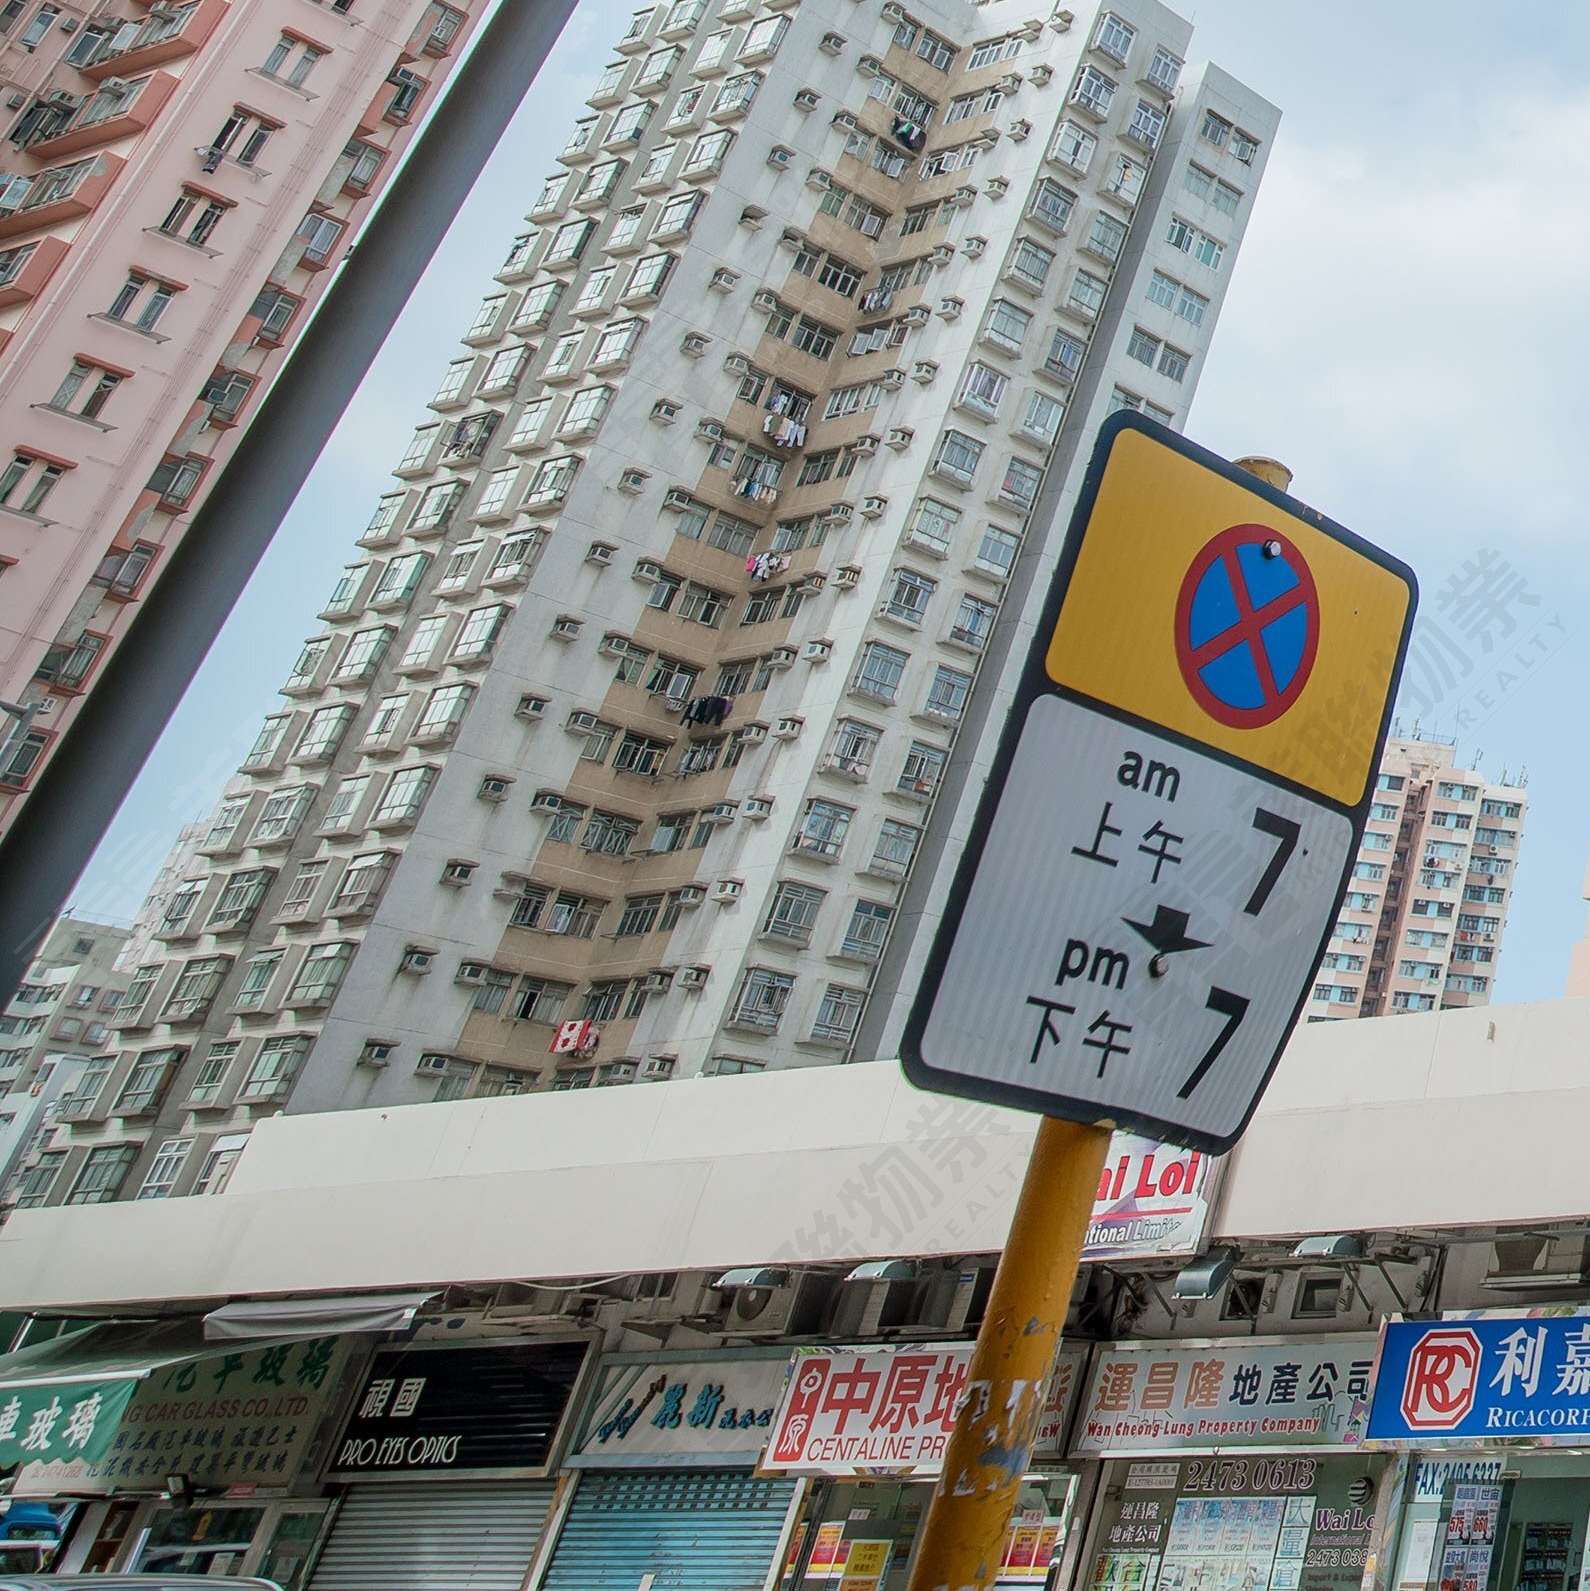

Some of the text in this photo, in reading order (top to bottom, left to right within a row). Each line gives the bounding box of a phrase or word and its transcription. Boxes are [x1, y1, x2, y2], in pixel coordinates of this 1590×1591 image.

[1117, 748, 1181, 803] am
[1071, 800, 1184, 885] 上午
[1244, 809, 1302, 917] 7
[1055, 931, 1131, 991] pm
[1025, 995, 1135, 1080] 下午
[1175, 986, 1251, 1101] 7
[1097, 1150, 1201, 1200] ai Loi
[1084, 1220, 1134, 1245] tional
[358, 1376, 428, 1418] 視國
[1094, 1357, 1375, 1412] 運昌隆地產公司
[144, 1402, 183, 1423] CAR
[183, 1398, 243, 1421] GLASS
[1087, 1415, 1320, 1439] Wan Cheong Lung Property Company
[338, 1435, 463, 1466] PRO EYES OPTICS
[807, 1437, 915, 1462] CENTALINE
[1183, 1458, 1317, 1491] 2473 0613
[1120, 1500, 1160, 1520] 運昌隆
[1315, 1508, 1351, 1531] Wai
[1449, 1516, 1465, 1533] 575
[1108, 1524, 1162, 1543] 地產公司
[1305, 1548, 1369, 1568] 2473 038
